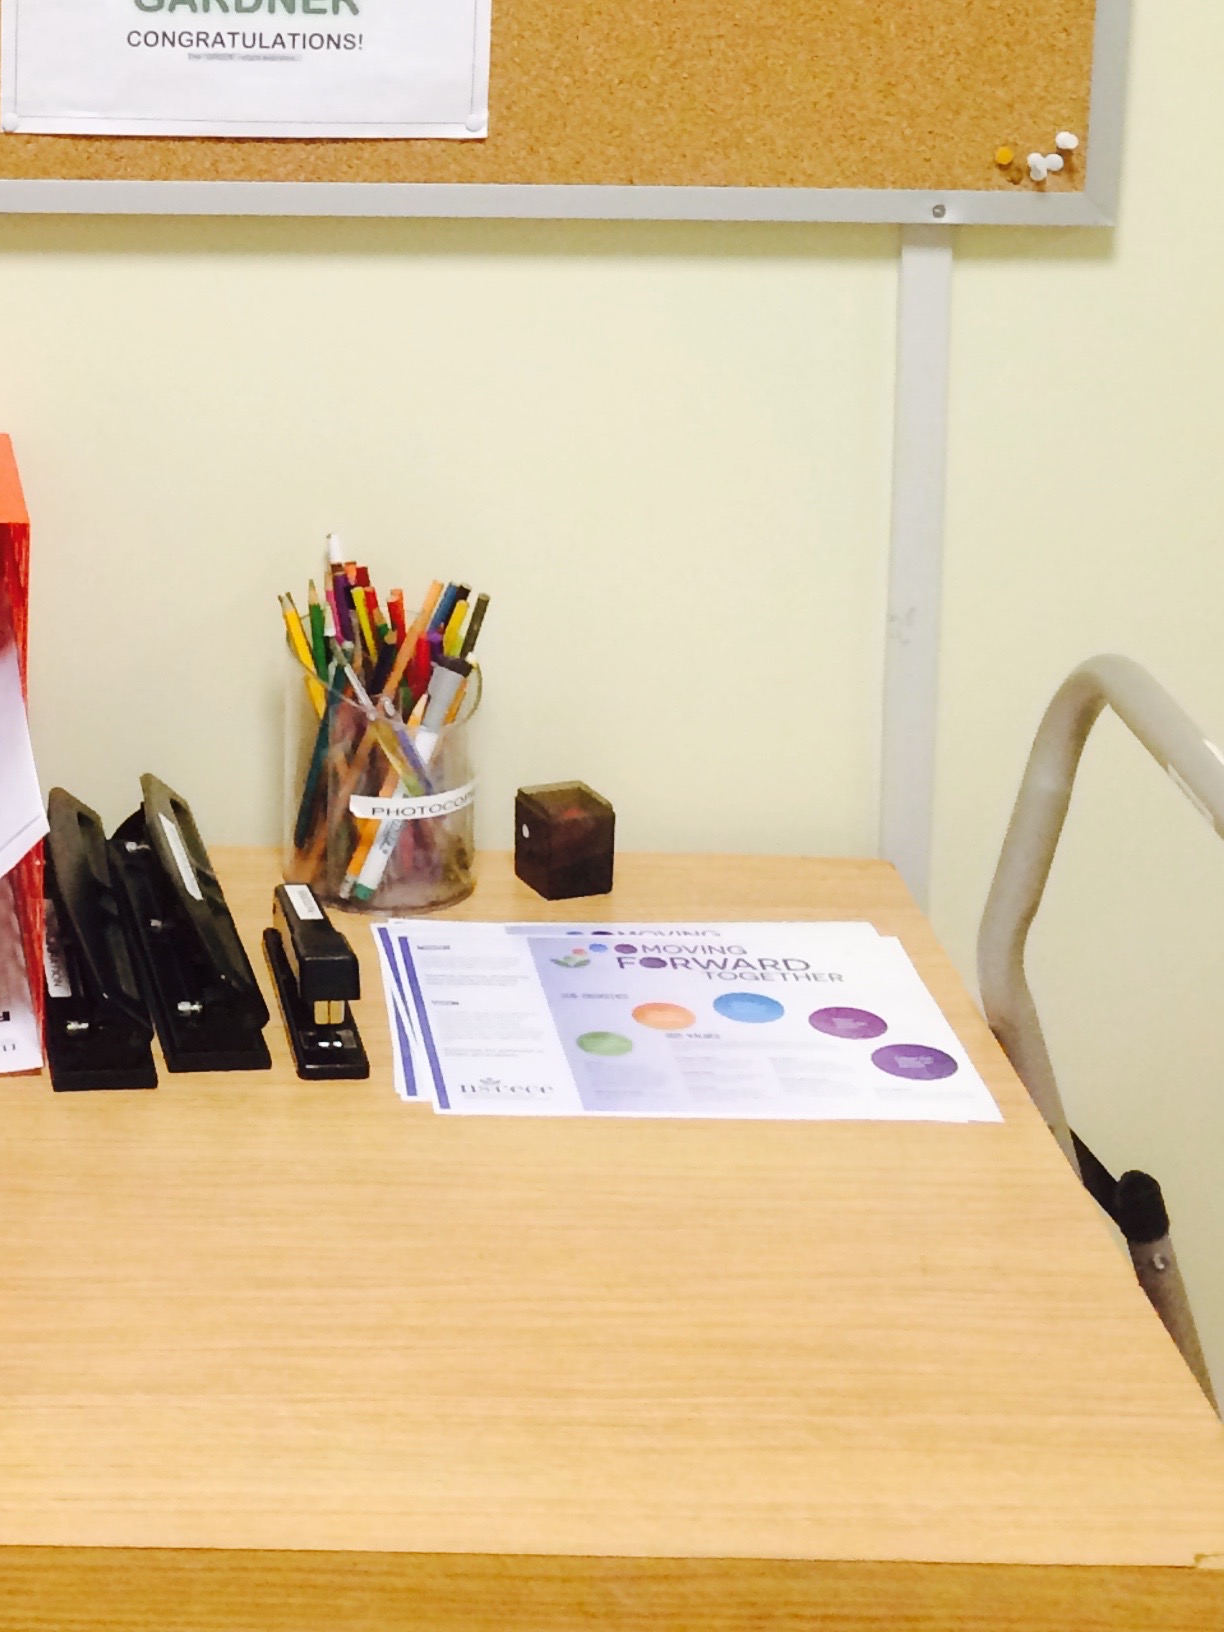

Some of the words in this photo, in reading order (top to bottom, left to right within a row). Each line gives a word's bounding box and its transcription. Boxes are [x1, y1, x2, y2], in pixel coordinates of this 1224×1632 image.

[126, 29, 364, 51] CONGRATULATIONS!
[371, 790, 475, 817] PHOTOCOP
[641, 943, 749, 956] MOVING
[616, 956, 812, 972] FORWARD
[704, 970, 845, 983] TOGETHER
